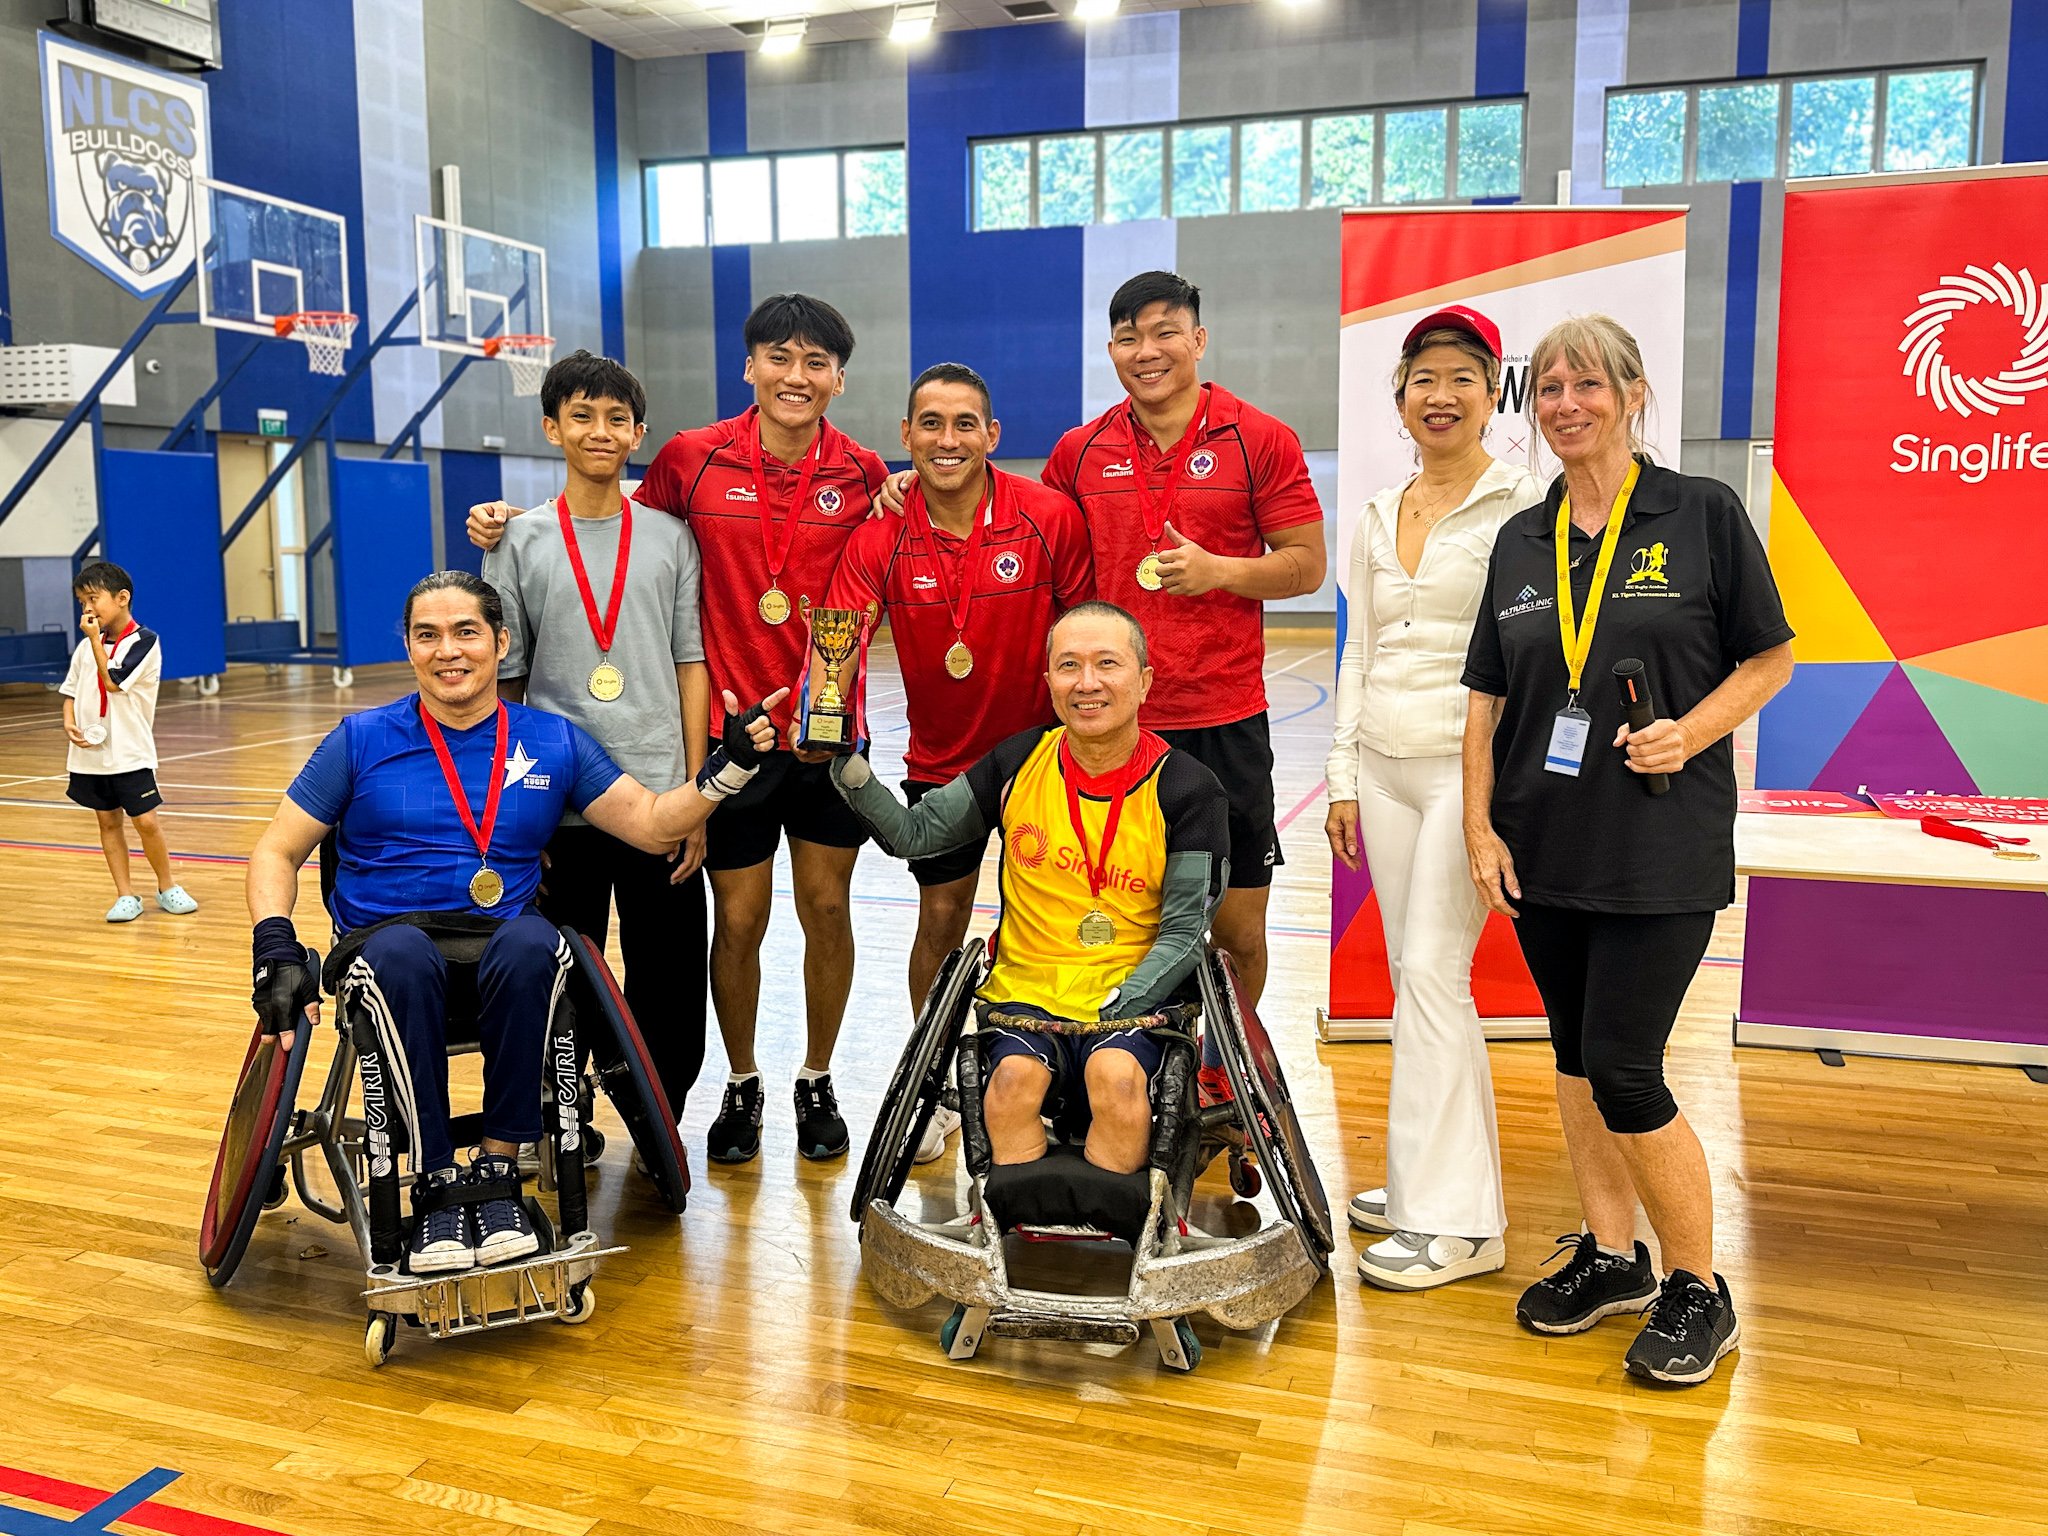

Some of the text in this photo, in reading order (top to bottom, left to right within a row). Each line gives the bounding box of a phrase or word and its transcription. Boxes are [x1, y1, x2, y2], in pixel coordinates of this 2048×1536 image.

[61, 65, 196, 157] NLCS
[71, 129, 192, 179] BULLDOGS
[1503, 354, 1522, 362] elchair
[1889, 432, 2048, 484] Singlife
[1102, 469, 1134, 478] tsunami
[725, 493, 758, 502] tsunam
[912, 582, 938, 590] tsunam
[523, 777, 550, 786] RUGBY
[1738, 799, 1849, 809] nglife
